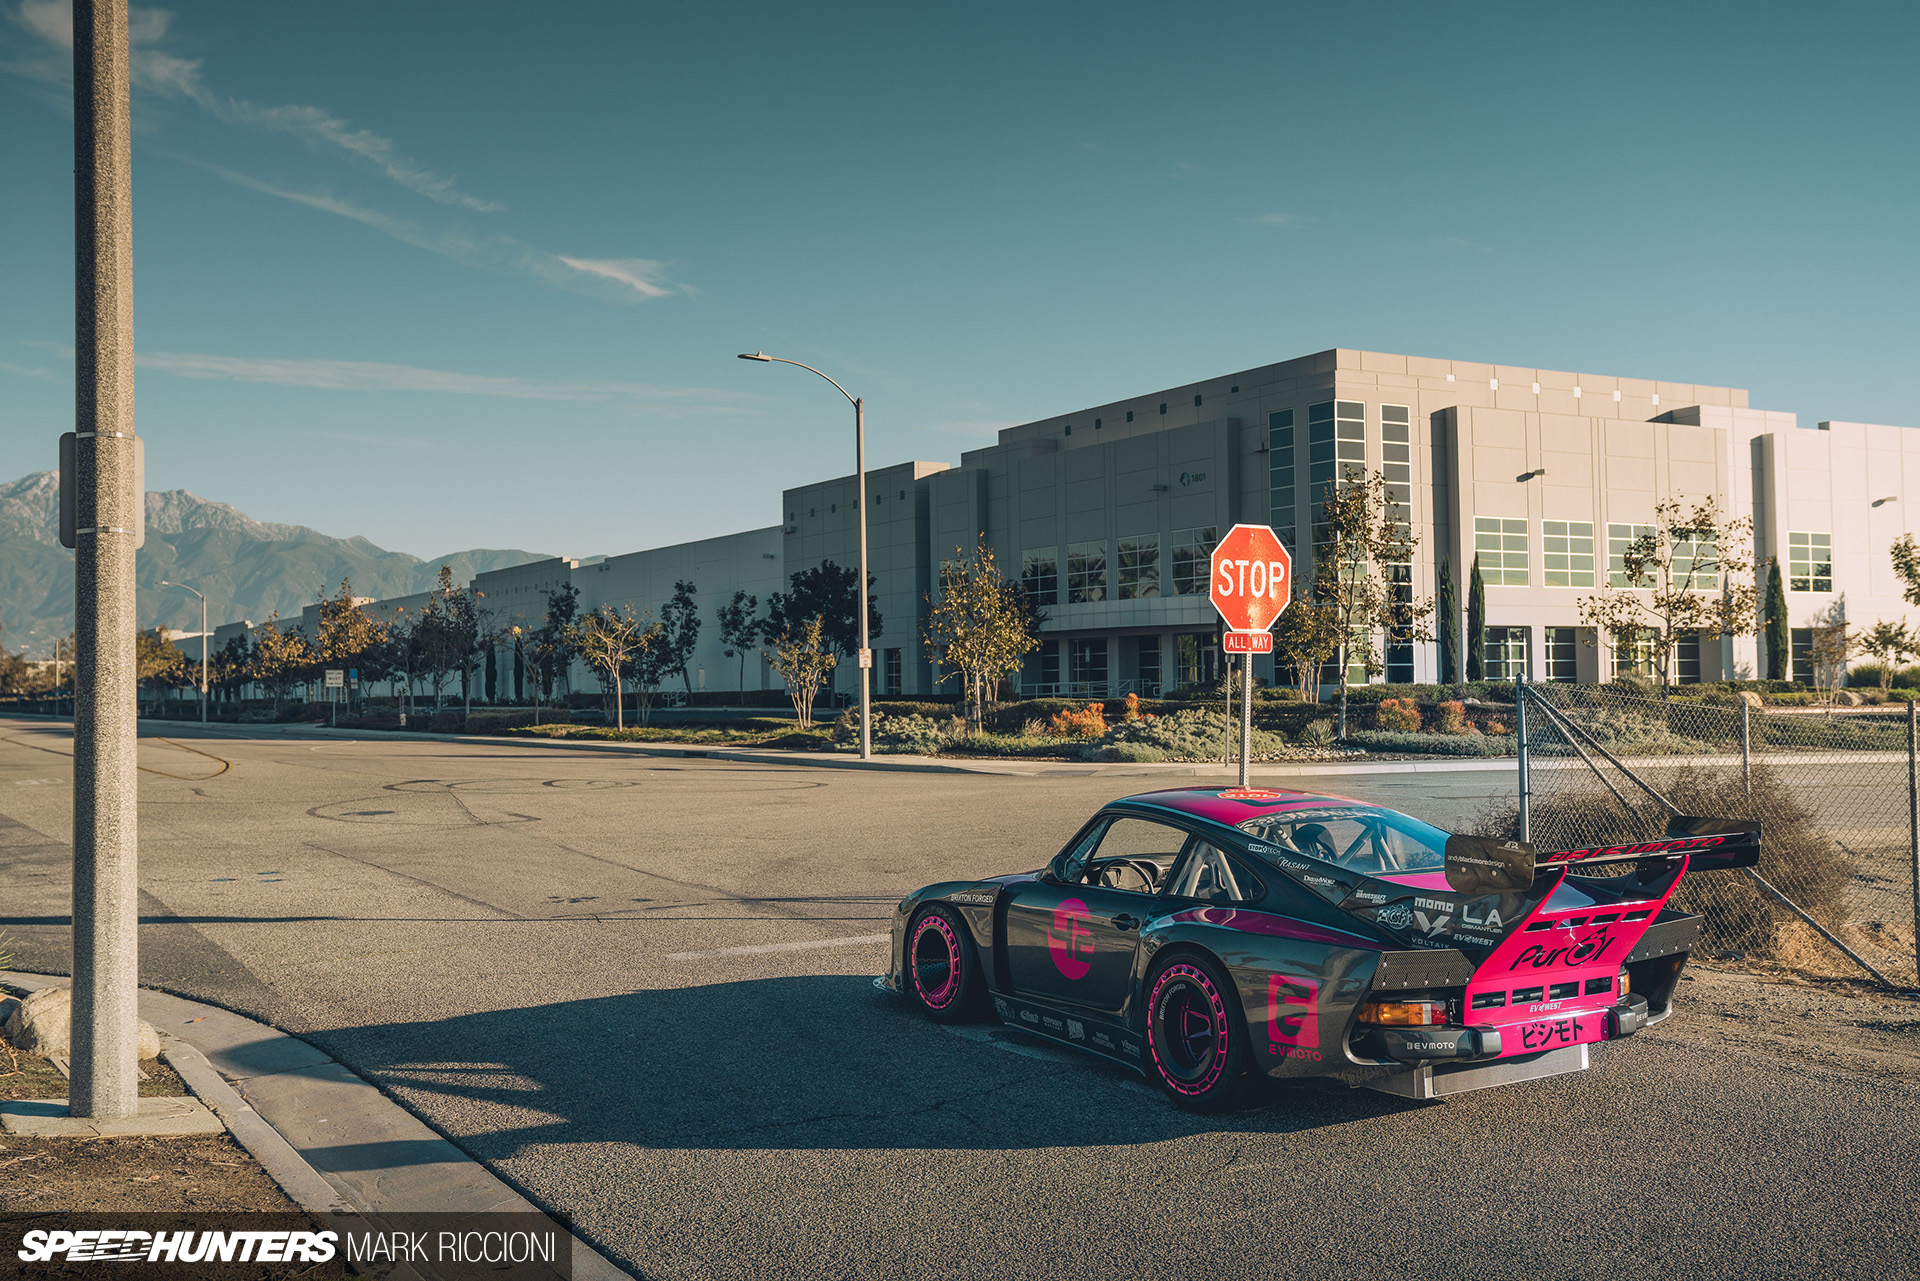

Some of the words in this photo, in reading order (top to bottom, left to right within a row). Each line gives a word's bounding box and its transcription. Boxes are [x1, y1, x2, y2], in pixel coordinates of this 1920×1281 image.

[1191, 472, 1206, 482] 1801
[1218, 559, 1285, 598] STOP
[1228, 637, 1246, 649] ALL
[1251, 637, 1269, 649] WAY
[1447, 855, 1505, 868] andyblackmoredesign
[950, 894, 972, 902] BRIXTON
[972, 894, 993, 903] FORGED
[1463, 905, 1503, 927] LA
[1159, 991, 1170, 1020] BRIXTON
[1522, 1017, 1583, 1049] ビシモト
[1269, 1044, 1322, 1061] EVMOTO
[1414, 1042, 1455, 1050] EVMOTO
